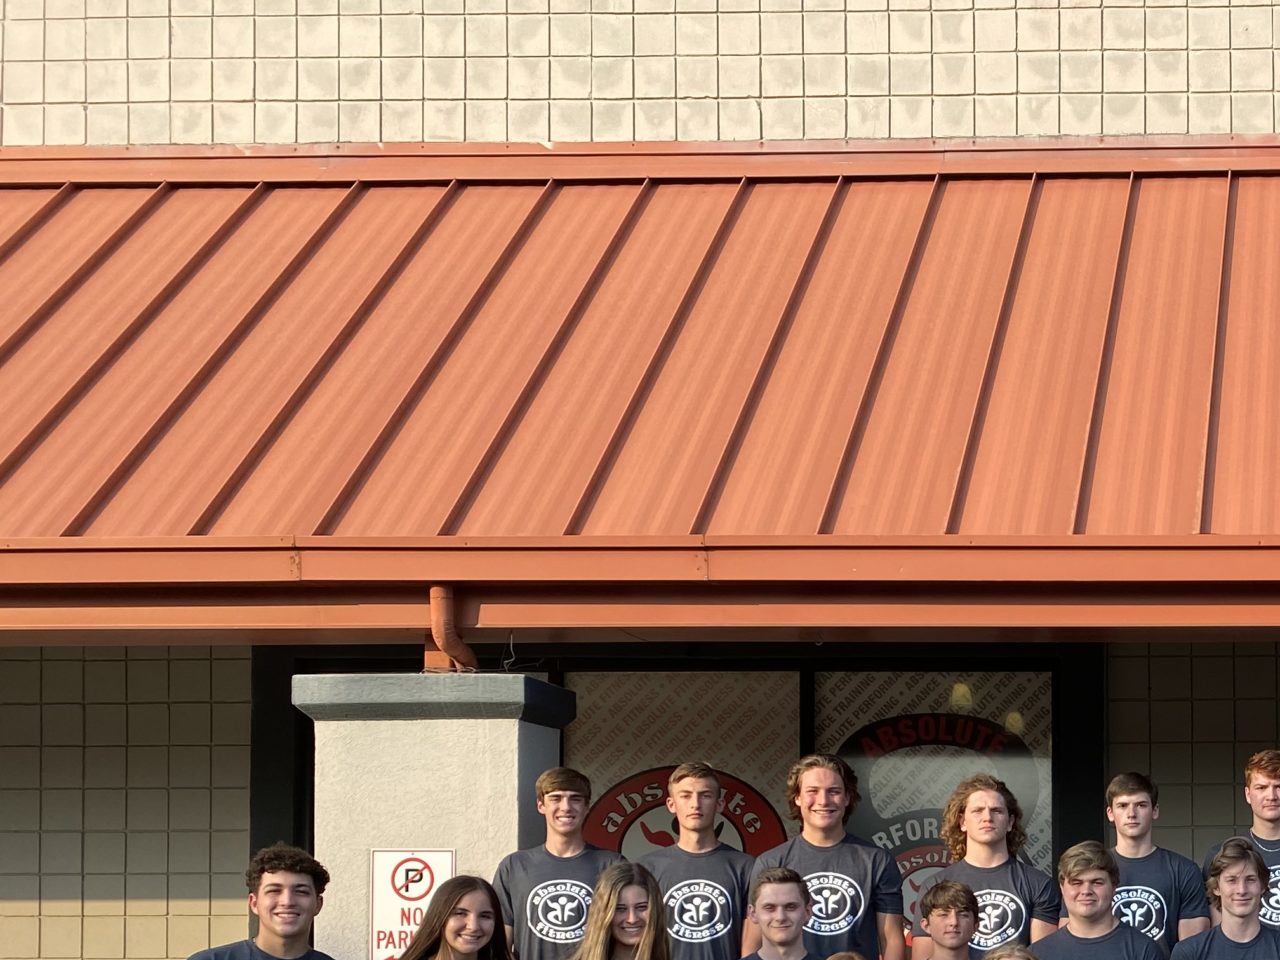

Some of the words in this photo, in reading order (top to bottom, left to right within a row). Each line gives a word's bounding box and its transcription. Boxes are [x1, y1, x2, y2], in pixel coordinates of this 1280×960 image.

[860, 716, 1008, 761] ABSOLUTE
[667, 882, 726, 908] absolute
[802, 876, 855, 897] bsolute
[1112, 889, 1161, 911] bsolute
[401, 907, 424, 926] NO
[805, 913, 854, 932] itness
[671, 922, 725, 939] fitness
[971, 927, 1016, 947] itness
